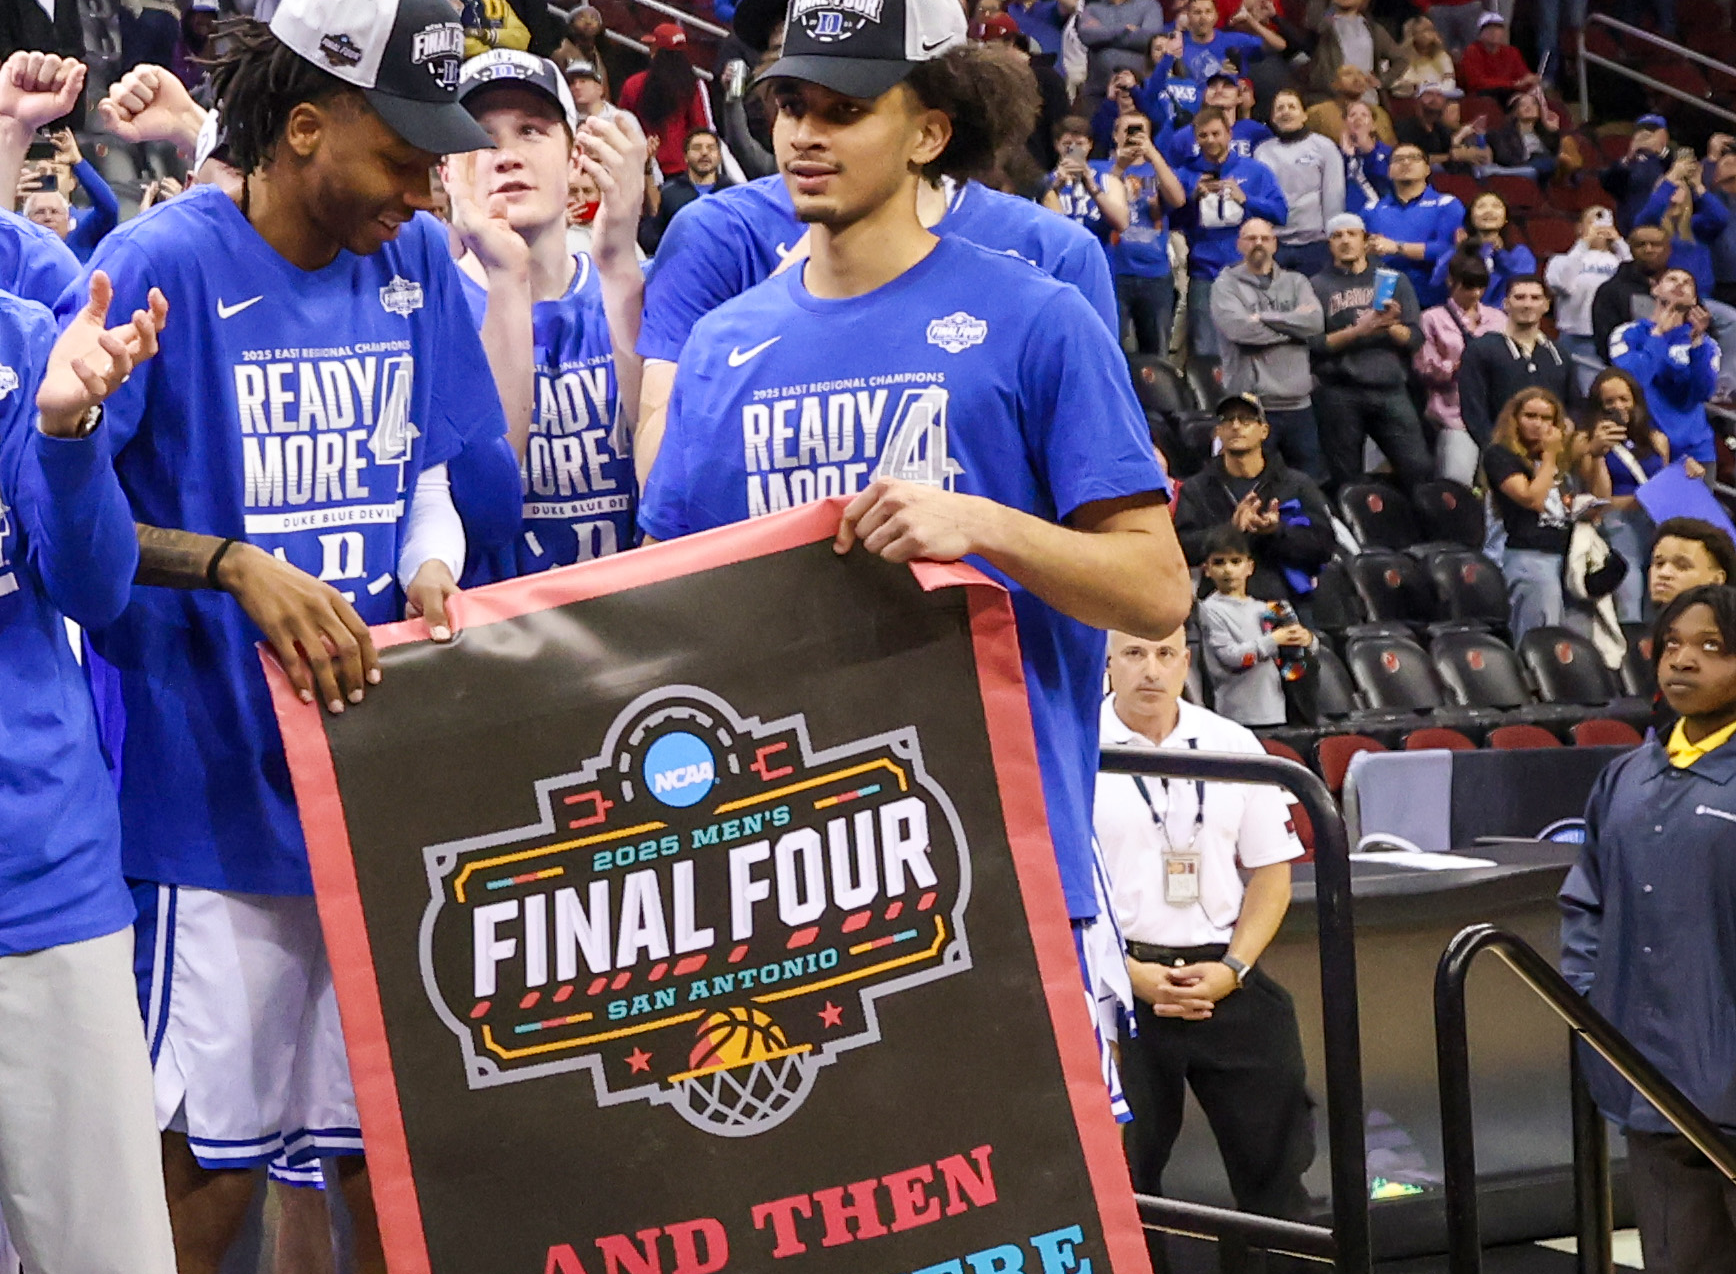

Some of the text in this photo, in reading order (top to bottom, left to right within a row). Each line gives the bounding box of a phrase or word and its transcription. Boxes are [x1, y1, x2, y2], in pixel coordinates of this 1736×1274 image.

[242, 349, 272, 362] 2025
[275, 347, 300, 360] EAST
[753, 371, 945, 401] 2025 EAST REGIONAL CHAMPIONS
[234, 356, 377, 434] READY
[522, 429, 617, 497] ORE
[742, 389, 889, 473] READY
[242, 429, 370, 508] MORE
[283, 510, 354, 528] DUKE BLUE
[654, 761, 715, 794] NCAA
[593, 806, 791, 873] 2025 MEN'S
[472, 796, 938, 999] FINAL FOUR
[608, 947, 840, 1021] SAN ANTONIO
[750, 1144, 999, 1259] THEN
